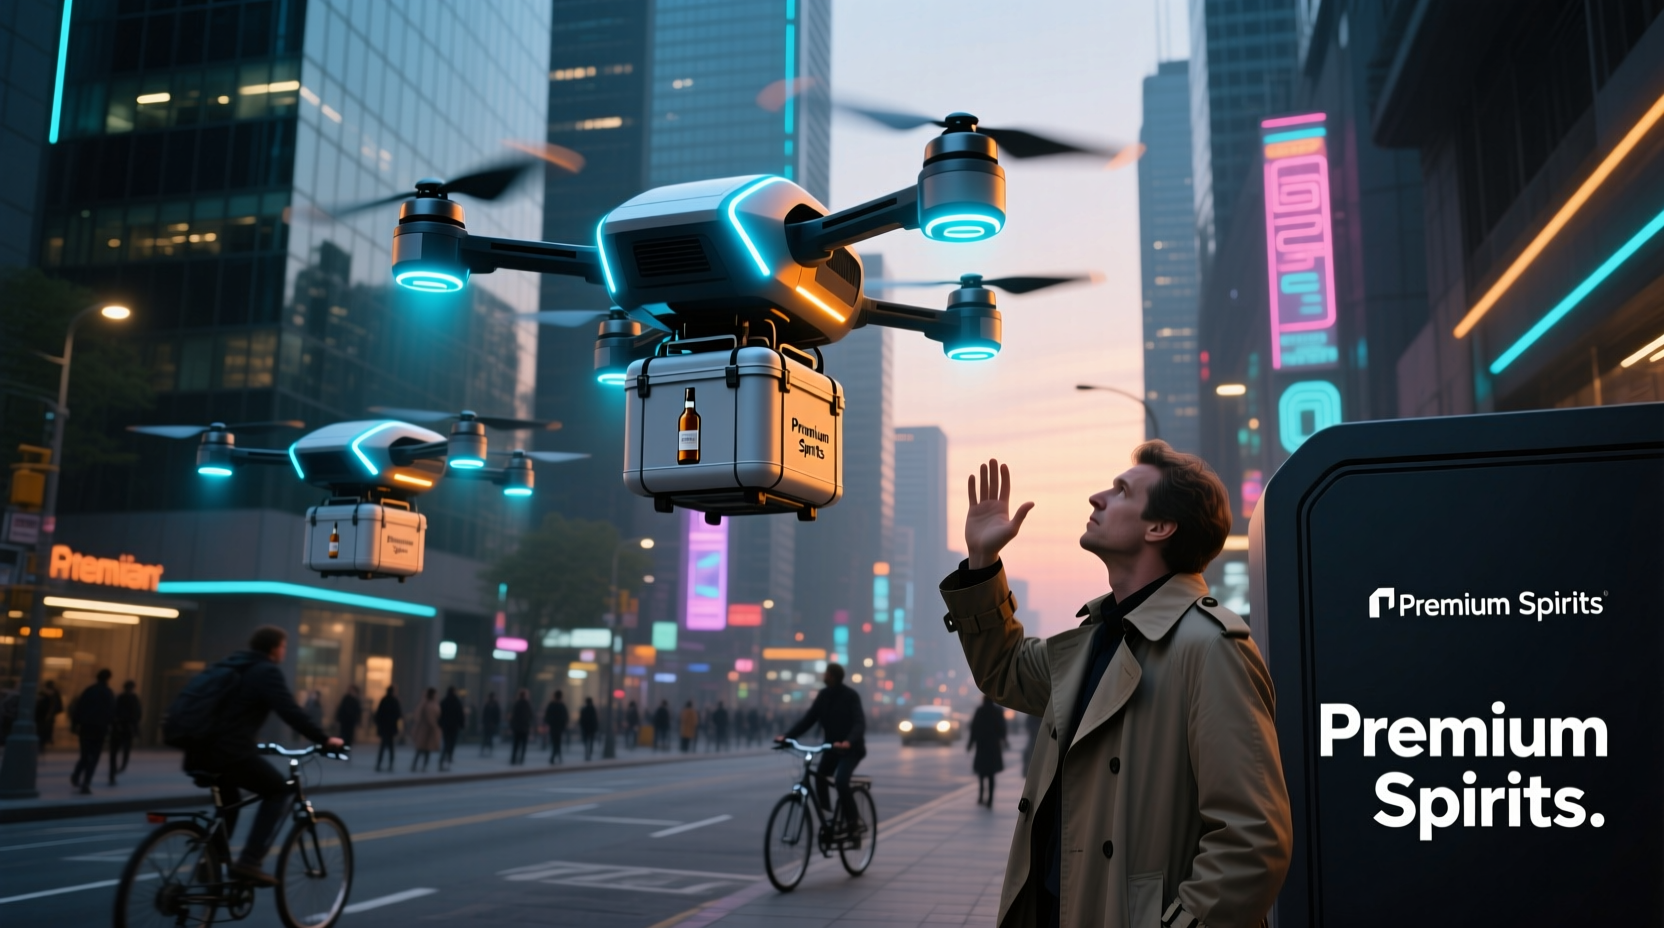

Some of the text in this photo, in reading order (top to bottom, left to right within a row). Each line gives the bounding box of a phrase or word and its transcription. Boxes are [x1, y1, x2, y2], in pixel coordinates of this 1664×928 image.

[1400, 590, 1604, 622] Premium Spirits
[1320, 701, 1608, 758] Premium
[1373, 770, 1605, 841] Spirits.
